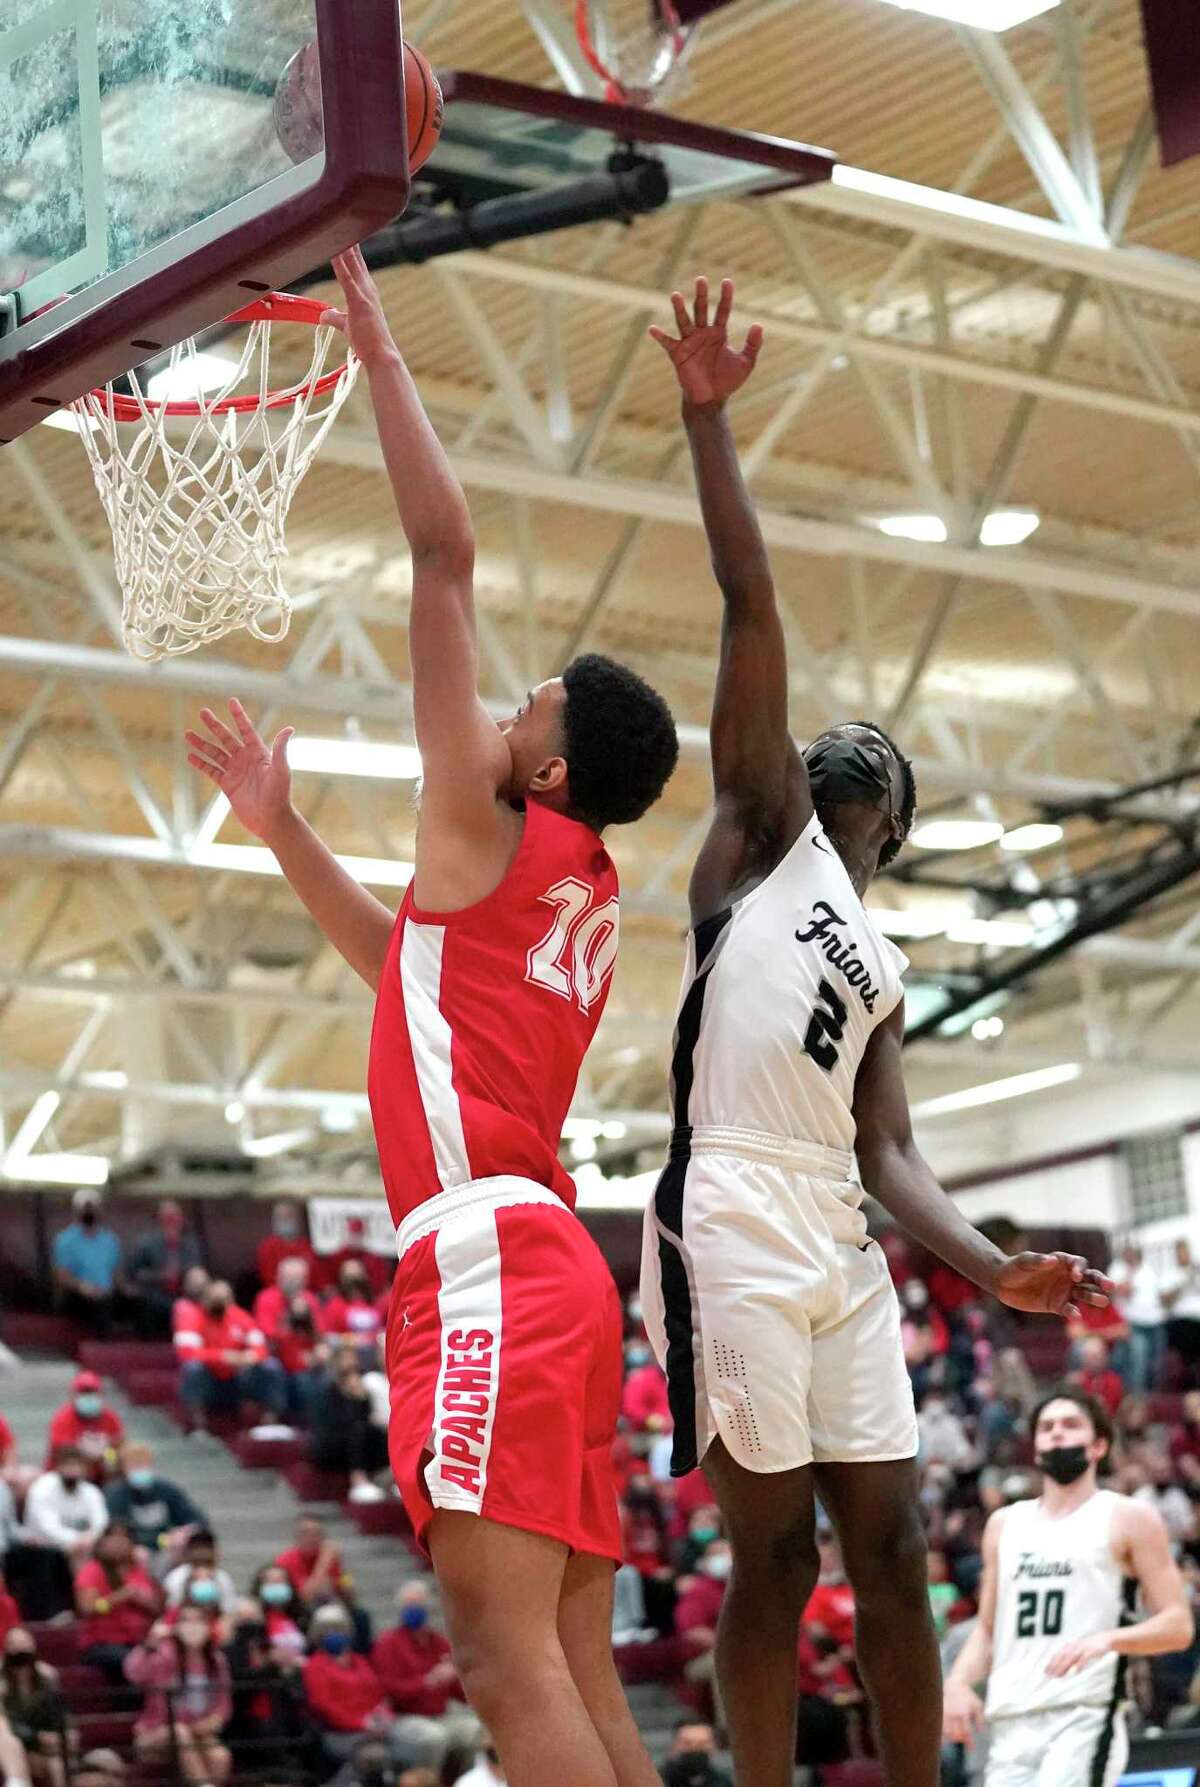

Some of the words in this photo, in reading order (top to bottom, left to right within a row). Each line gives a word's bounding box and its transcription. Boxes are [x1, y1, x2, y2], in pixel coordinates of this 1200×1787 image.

[523, 875, 620, 1017] 20
[795, 900, 880, 1015] Friars
[801, 975, 849, 1075] 2
[440, 1328, 494, 1496] APACHES
[1012, 1551, 1074, 1580] Friars
[1016, 1588, 1065, 1639] 20
